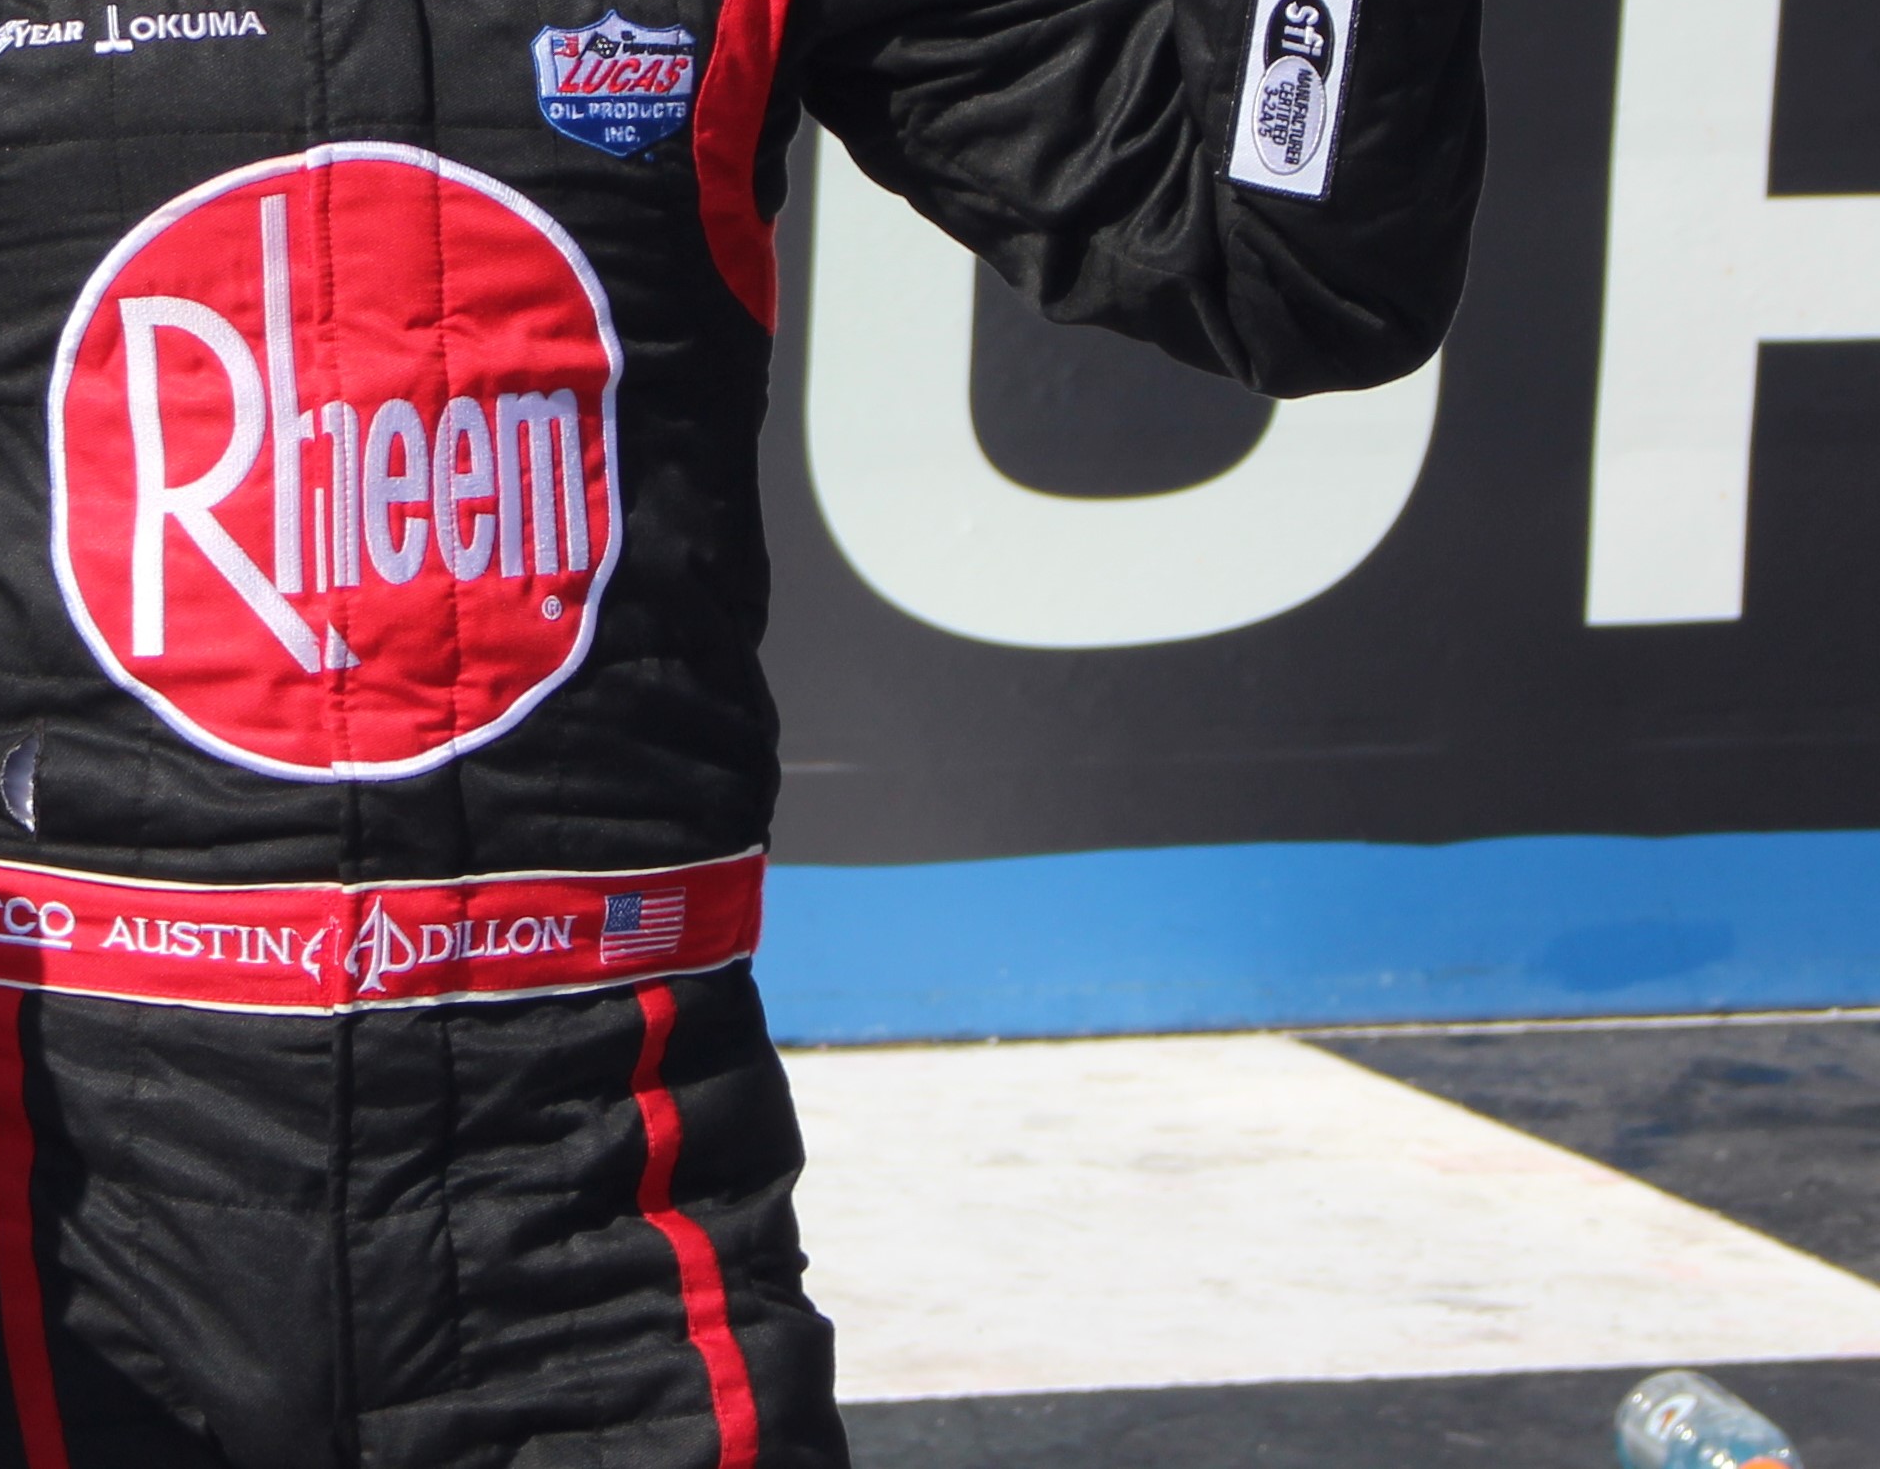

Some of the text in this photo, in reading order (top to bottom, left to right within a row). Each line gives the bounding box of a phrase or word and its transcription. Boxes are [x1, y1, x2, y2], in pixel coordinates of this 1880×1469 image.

[130, 10, 268, 43] OKUMA
[556, 57, 689, 94] LUCAS
[549, 102, 687, 119] OIL PRODUCTS
[604, 125, 641, 143] INC.
[1257, 84, 1280, 139] 3-2A/5
[1271, 80, 1296, 147] CERTIFIED
[1284, 67, 1314, 166] MANUFACTURER
[118, 192, 590, 675] Rheem
[102, 914, 293, 963] AUSTIN
[420, 914, 577, 961] DILLON
